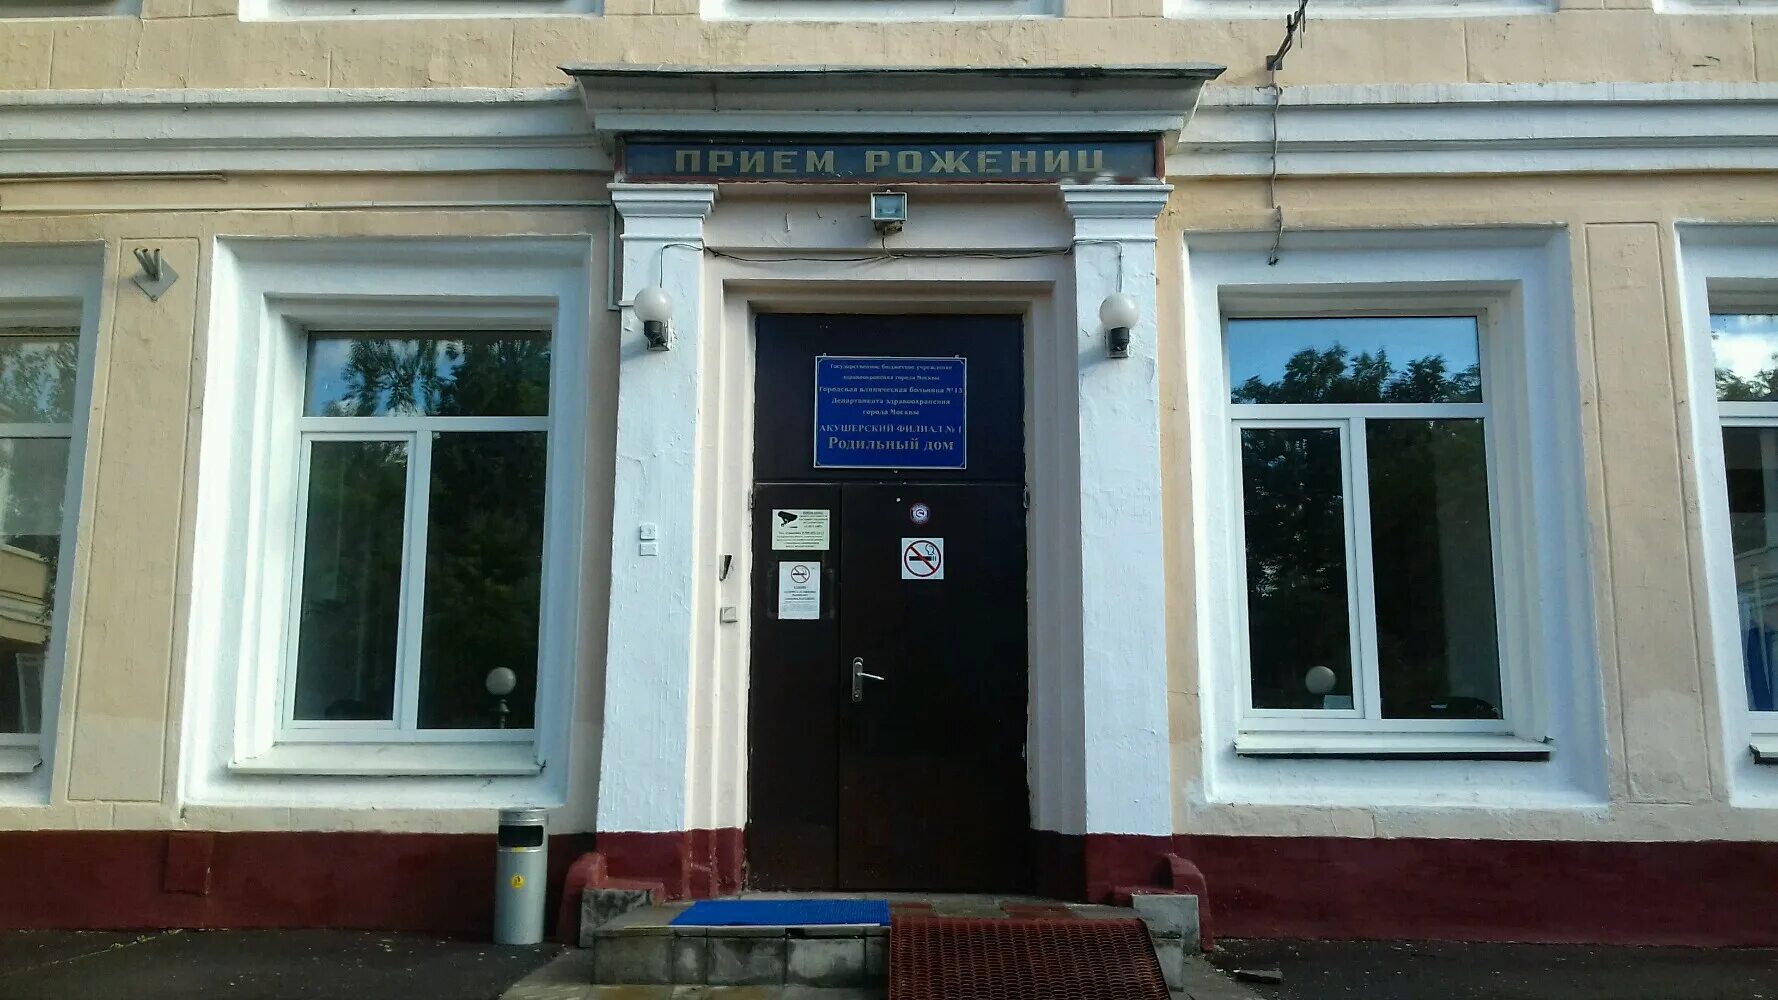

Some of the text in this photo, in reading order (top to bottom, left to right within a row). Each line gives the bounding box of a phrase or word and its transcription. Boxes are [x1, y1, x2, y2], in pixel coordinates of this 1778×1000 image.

[675, 150, 1103, 174] ПРИЕМ РОЖЕНИЦ
[819, 386, 857, 394] Городская
[831, 397, 883, 405] Департамента
[819, 424, 894, 432] АКУШЕРСКИЙ
[896, 425, 942, 433] ФИЛИАЛ
